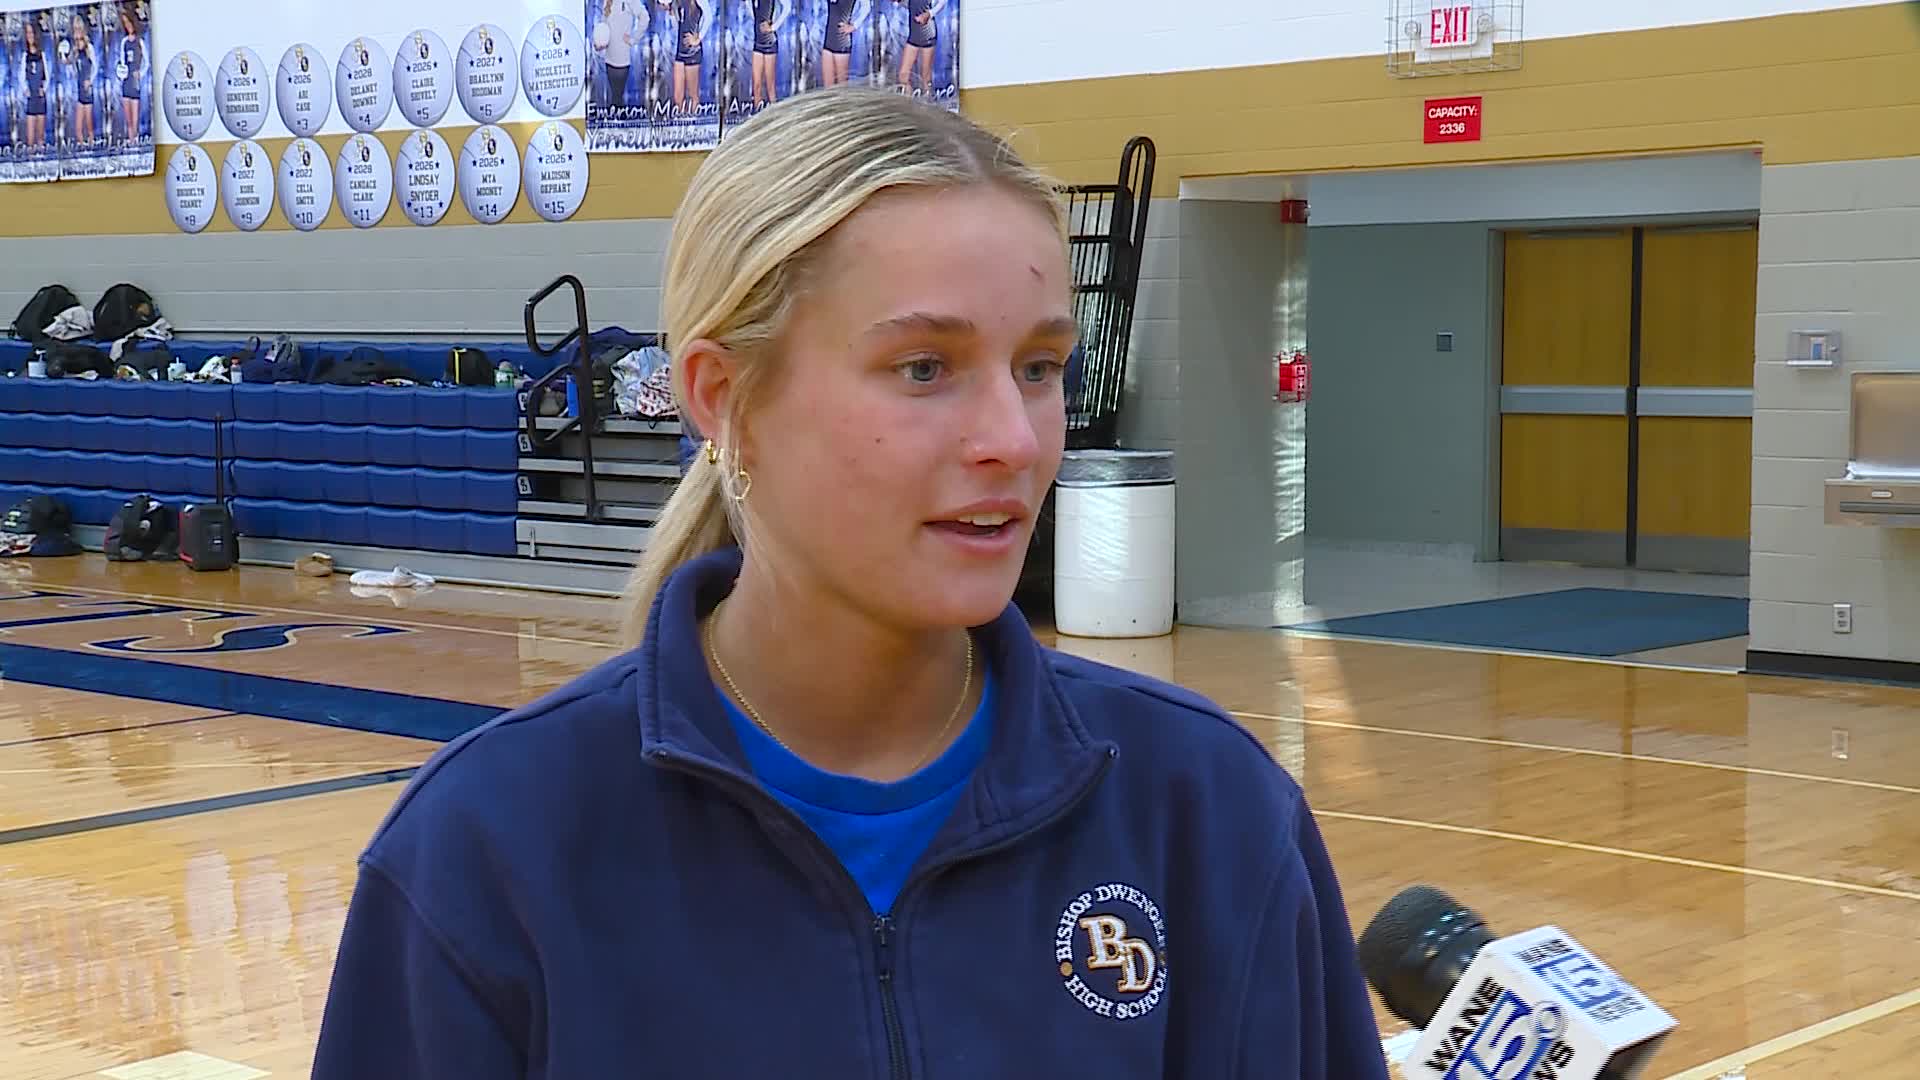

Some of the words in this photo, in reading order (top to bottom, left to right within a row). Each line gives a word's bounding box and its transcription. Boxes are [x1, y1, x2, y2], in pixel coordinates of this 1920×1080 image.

[1431, 6, 1471, 44] EXIT
[542, 48, 563, 60] 2026
[476, 57, 496, 68] 2027
[353, 68, 373, 80] 2028
[535, 64, 572, 78] NICOLETTE
[586, 101, 648, 121] Emerson
[1428, 105, 1478, 119] CAPACITY:
[1439, 122, 1465, 135] 2336
[545, 154, 566, 164] 2026
[409, 174, 440, 187] LINDSAY
[540, 170, 571, 181] MADISON
[410, 190, 439, 202] SNYDER
[1056, 892, 1092, 962] BISHOP
[1079, 914, 1156, 992] BD
[1064, 974, 1113, 1017] HIGH
[1115, 967, 1167, 1019] SCHOOL
[1423, 976, 1504, 1072] WANE
